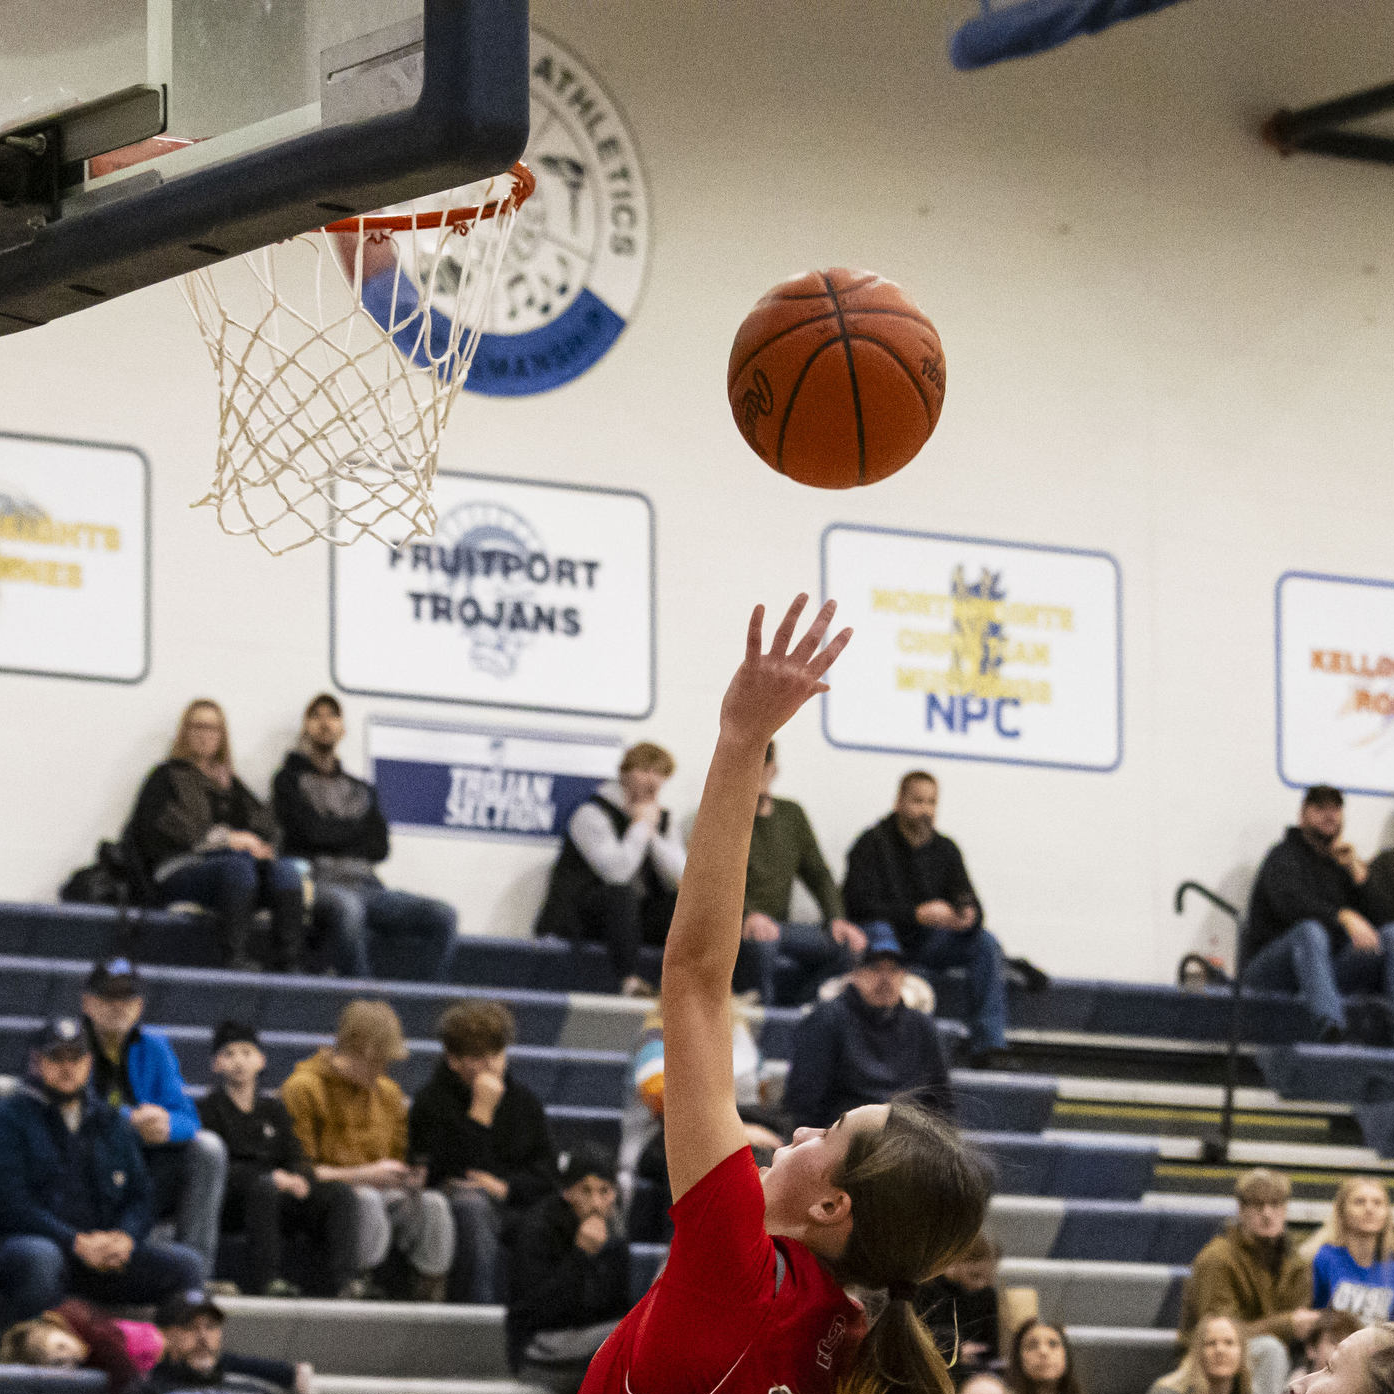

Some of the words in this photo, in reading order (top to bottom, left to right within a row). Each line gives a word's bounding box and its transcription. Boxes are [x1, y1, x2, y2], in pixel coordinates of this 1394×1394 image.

[534, 55, 637, 257] ATHLETICS
[389, 542, 601, 590] FRUITPORT
[408, 593, 582, 637] TROJANS
[926, 693, 1022, 738] NPC
